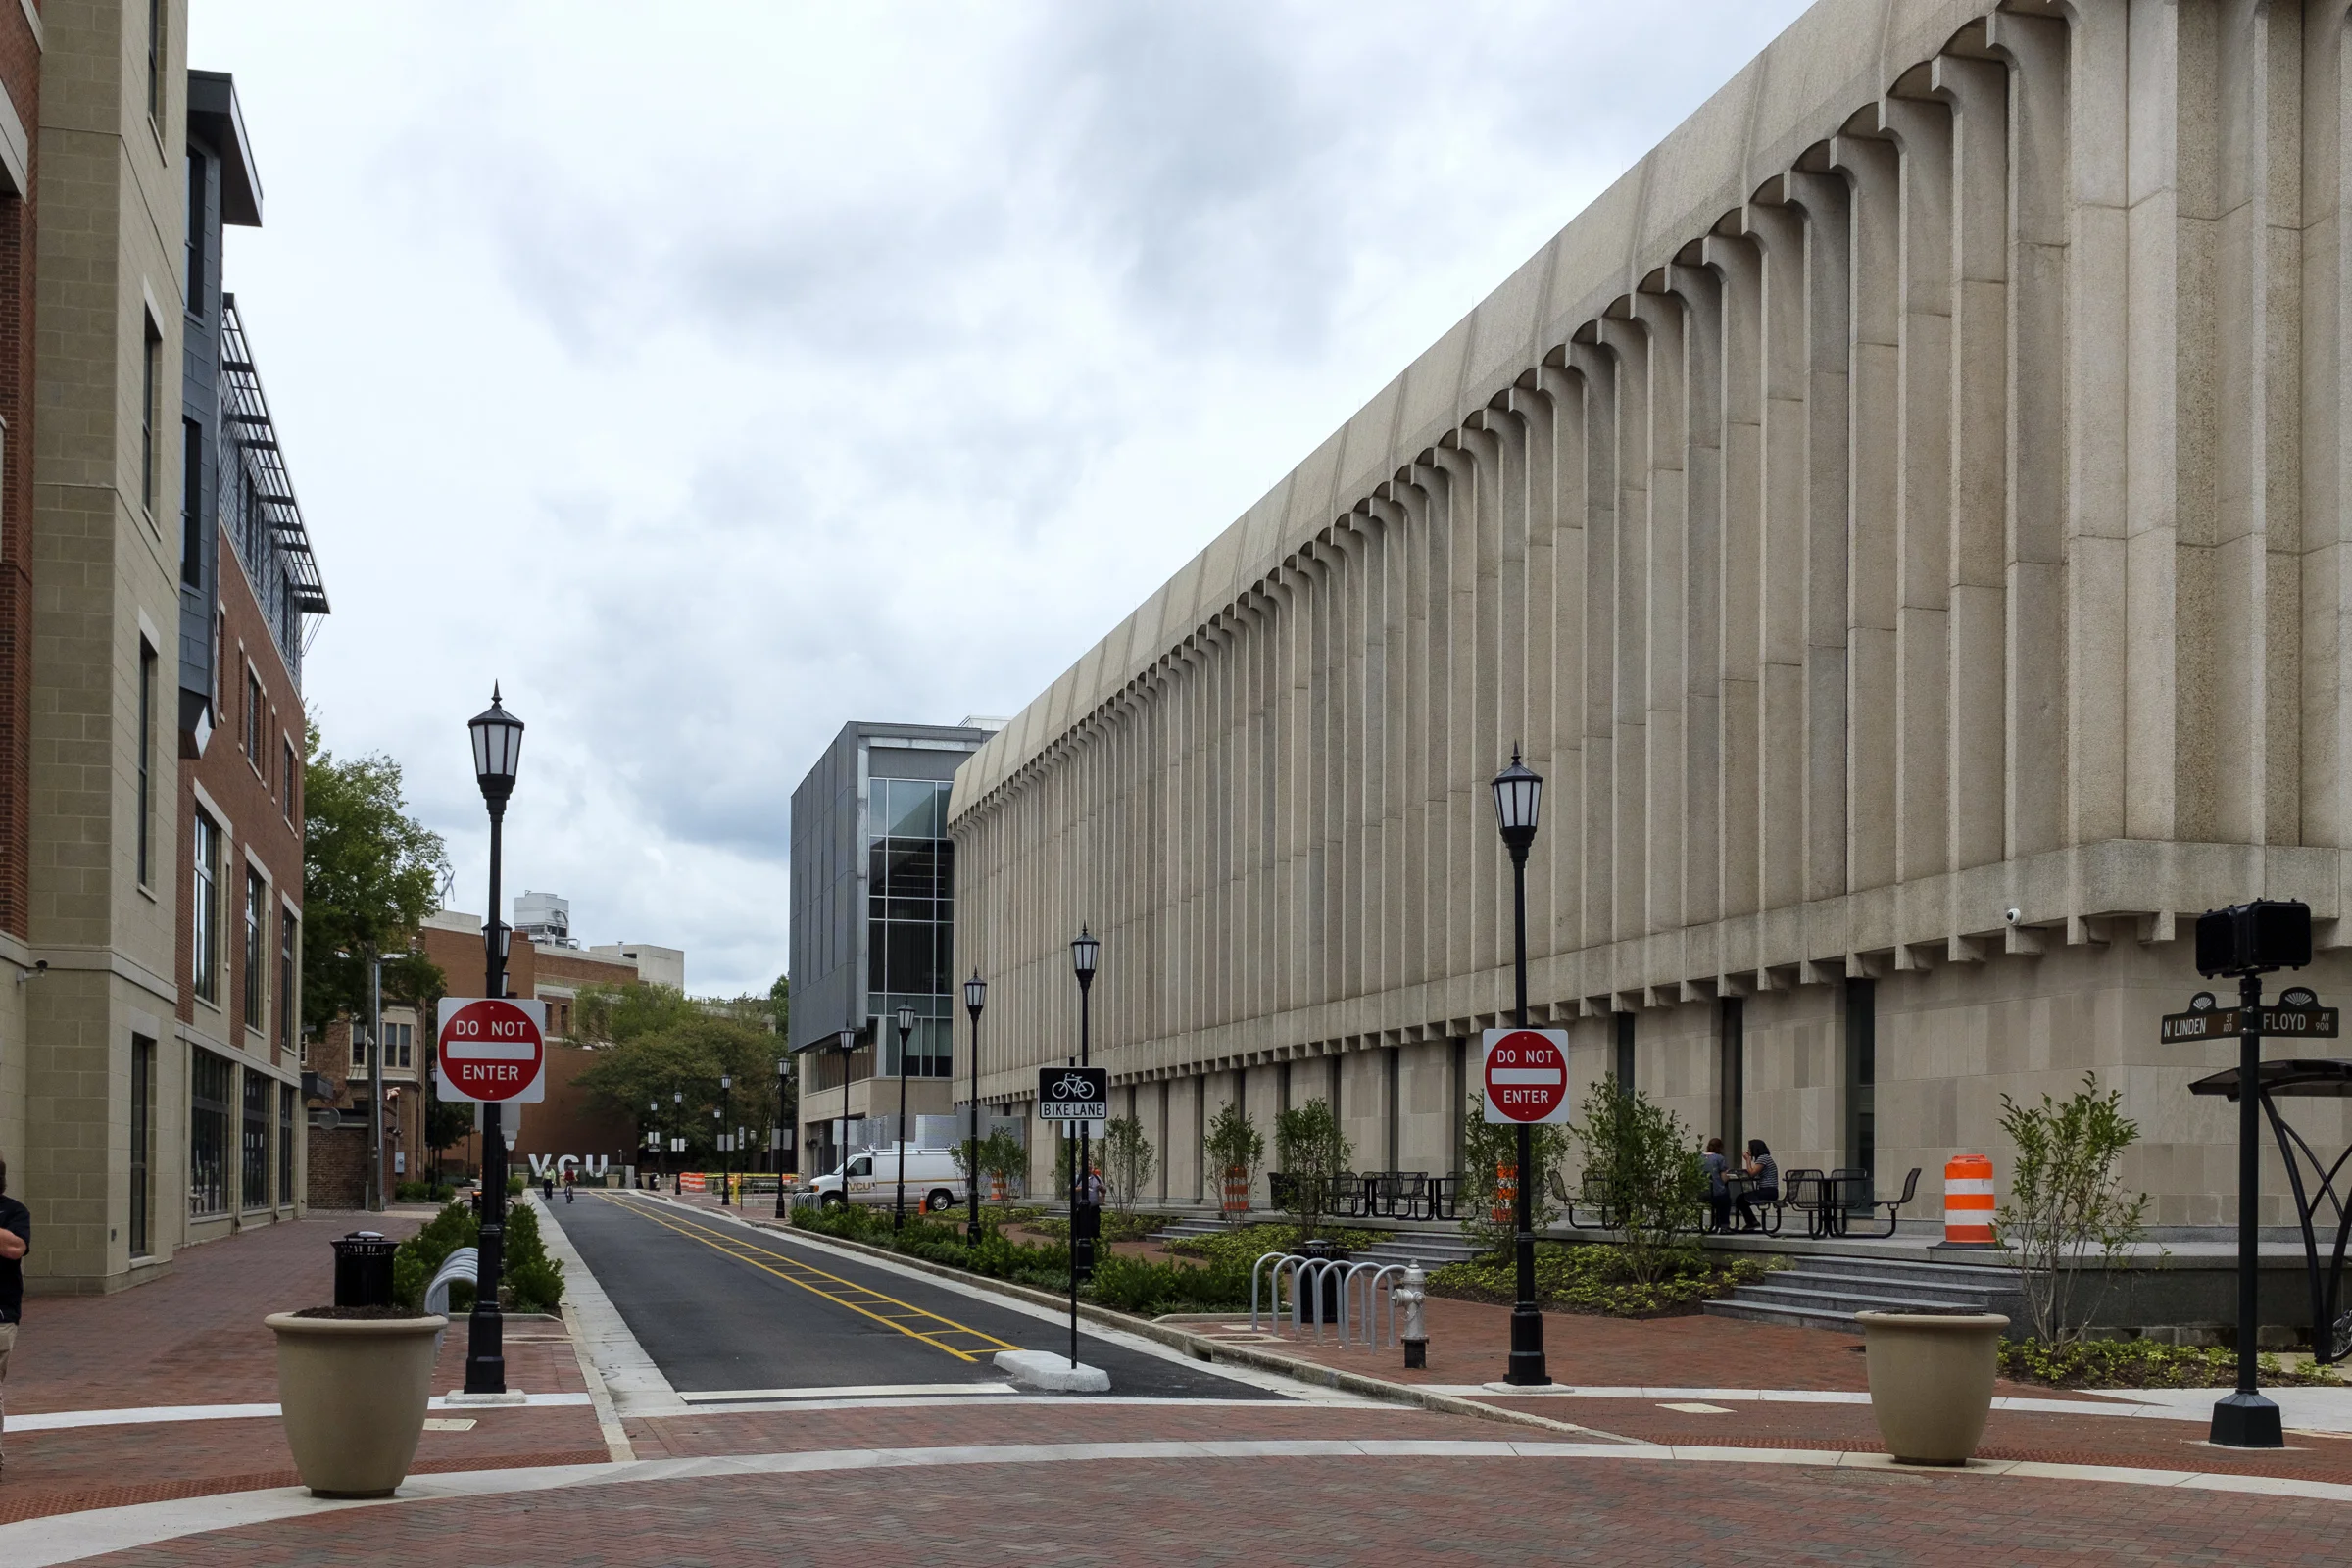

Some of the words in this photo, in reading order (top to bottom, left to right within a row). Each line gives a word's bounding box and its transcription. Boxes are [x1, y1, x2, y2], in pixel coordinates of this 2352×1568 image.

[2226, 1013, 2233, 1022] ST
[2263, 1013, 2306, 1030] FLOYD
[456, 1020, 479, 1035] DO
[491, 1021, 526, 1036] NOT
[2164, 1021, 2171, 1037] N
[2174, 1017, 2207, 1036] LINDEN
[2315, 1022, 2329, 1031] 900
[1496, 1050, 1516, 1063] DO
[1525, 1050, 1553, 1063] NOT
[463, 1065, 518, 1080] ENTER
[1503, 1090, 1548, 1103] ENTER
[1044, 1103, 1070, 1115] BIKE
[1073, 1103, 1102, 1115] LANE
[528, 1153, 608, 1178] VCU
[849, 1182, 870, 1191] VCU
